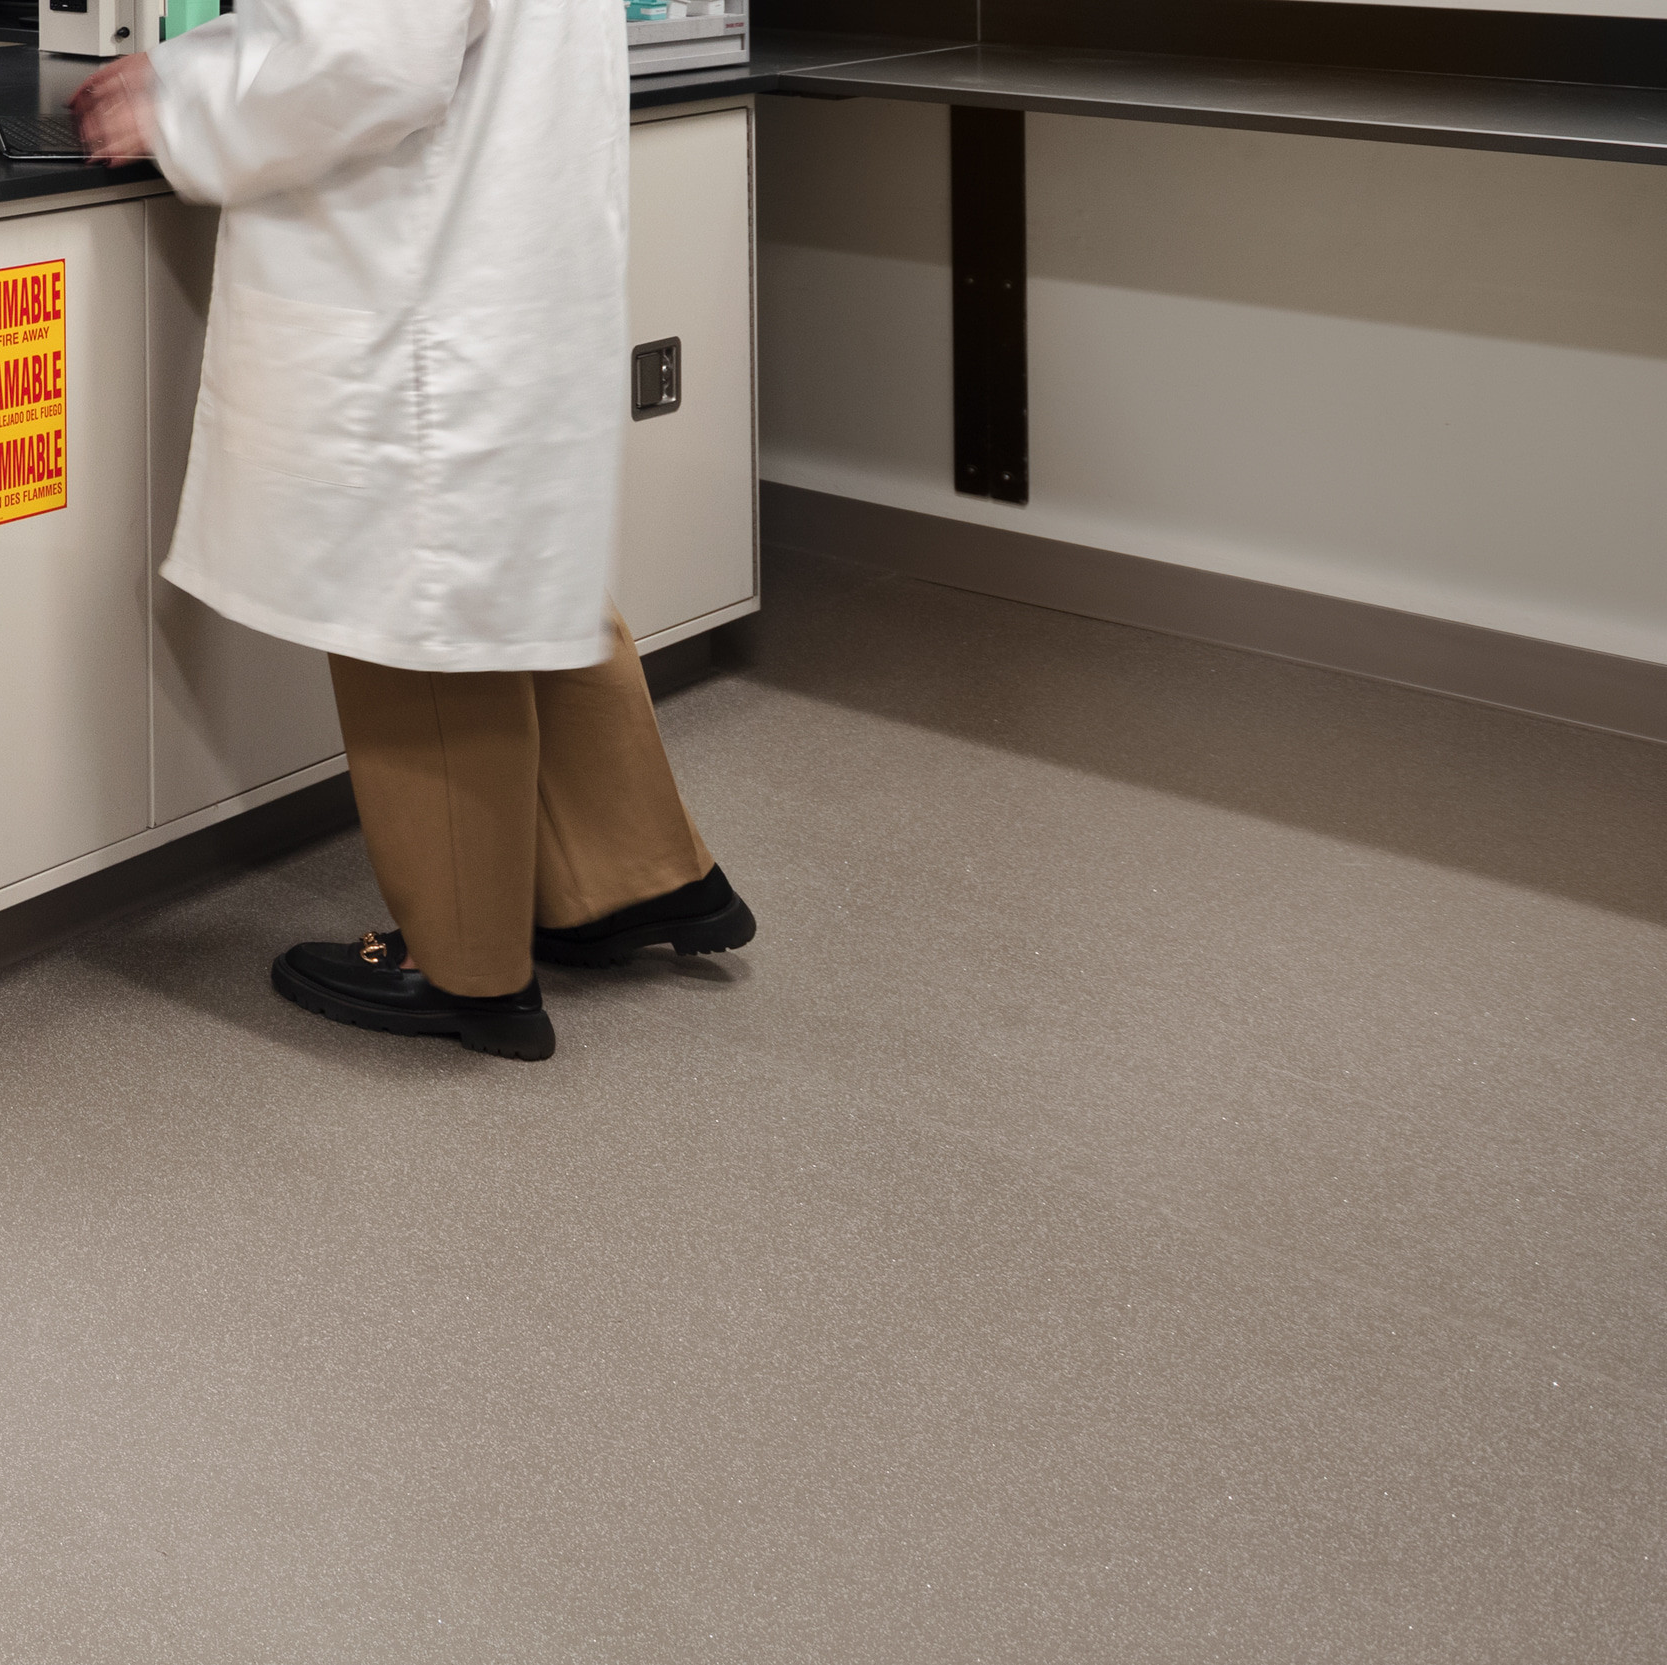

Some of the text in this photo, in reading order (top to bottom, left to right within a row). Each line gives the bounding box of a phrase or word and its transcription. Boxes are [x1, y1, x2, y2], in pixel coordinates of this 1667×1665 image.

[22, 326, 50, 343] AWAY
[26, 408, 39, 422] DEL
[40, 403, 62, 419] FUEGO
[5, 493, 21, 507] DES
[23, 482, 63, 503] FLAMMES
